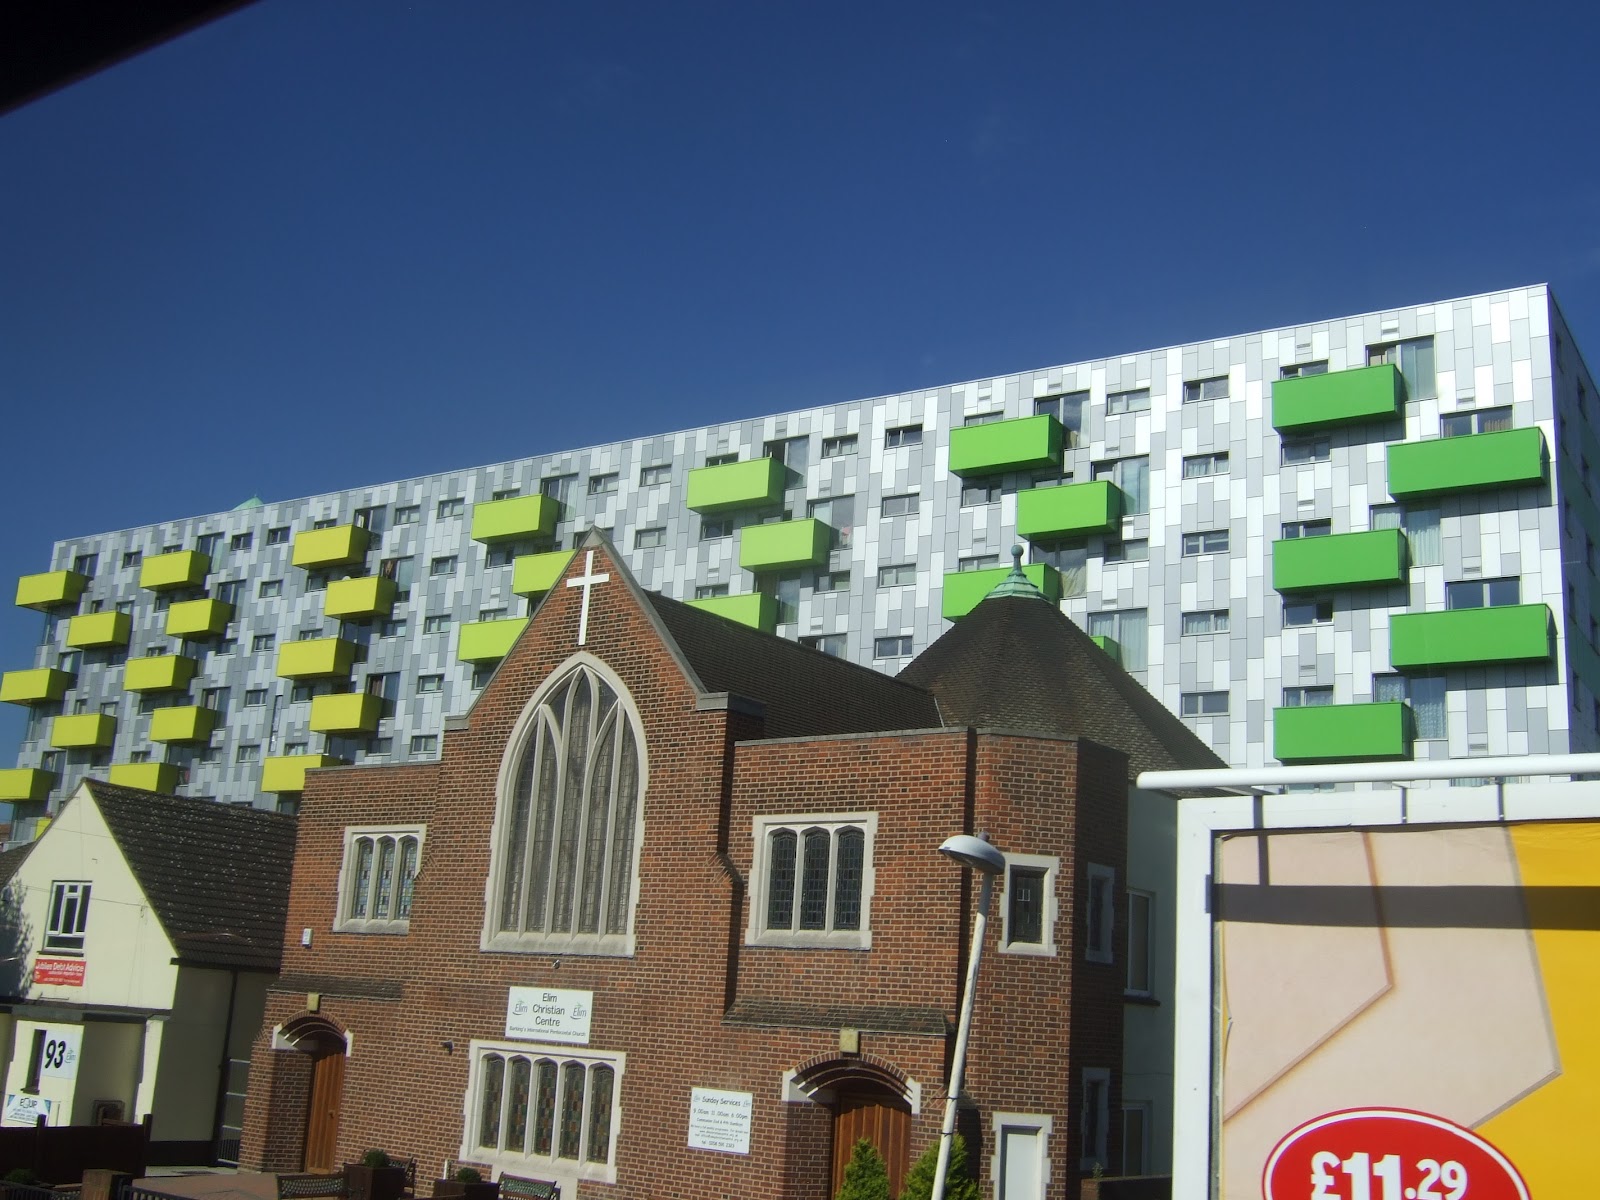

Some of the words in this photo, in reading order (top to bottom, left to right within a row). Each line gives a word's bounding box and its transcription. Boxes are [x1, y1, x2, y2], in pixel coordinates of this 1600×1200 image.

[53, 962, 65, 970] Debt
[66, 963, 84, 972] Advice
[542, 993, 558, 1003] Elim
[514, 1002, 528, 1013] Elim
[532, 1004, 566, 1015] Christian
[572, 1007, 587, 1017] Elim
[535, 1016, 561, 1027] Centre
[45, 1040, 66, 1068] 93
[702, 1096, 719, 1105] Sunday
[720, 1098, 741, 1107] Services
[1311, 1151, 1468, 1200] £11.29
